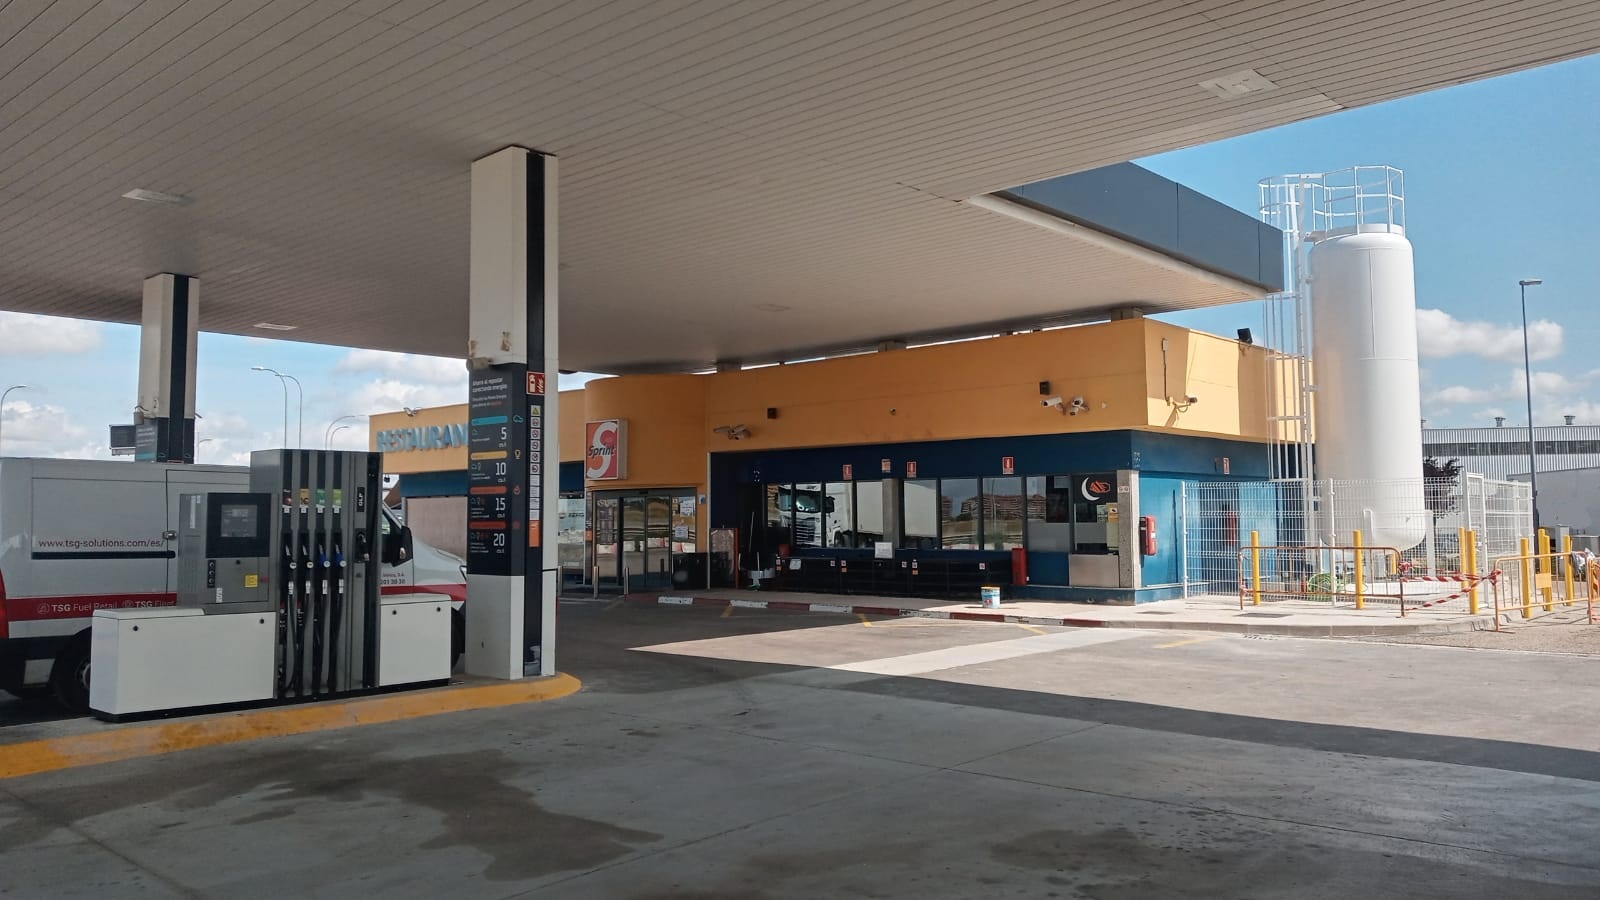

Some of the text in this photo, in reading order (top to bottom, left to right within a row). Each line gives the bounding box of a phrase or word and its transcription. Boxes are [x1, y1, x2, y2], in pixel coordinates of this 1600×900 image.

[376, 423, 468, 452] RESTAURAN
[501, 426, 507, 440] 5
[588, 446, 616, 458] Sprint
[496, 462, 506, 476] 10
[496, 498, 506, 510] 15
[38, 539, 164, 548] www.tsg-solutions.com/es/
[494, 533, 504, 546] 20
[51, 604, 71, 612] TSG
[73, 603, 92, 612] Fuel
